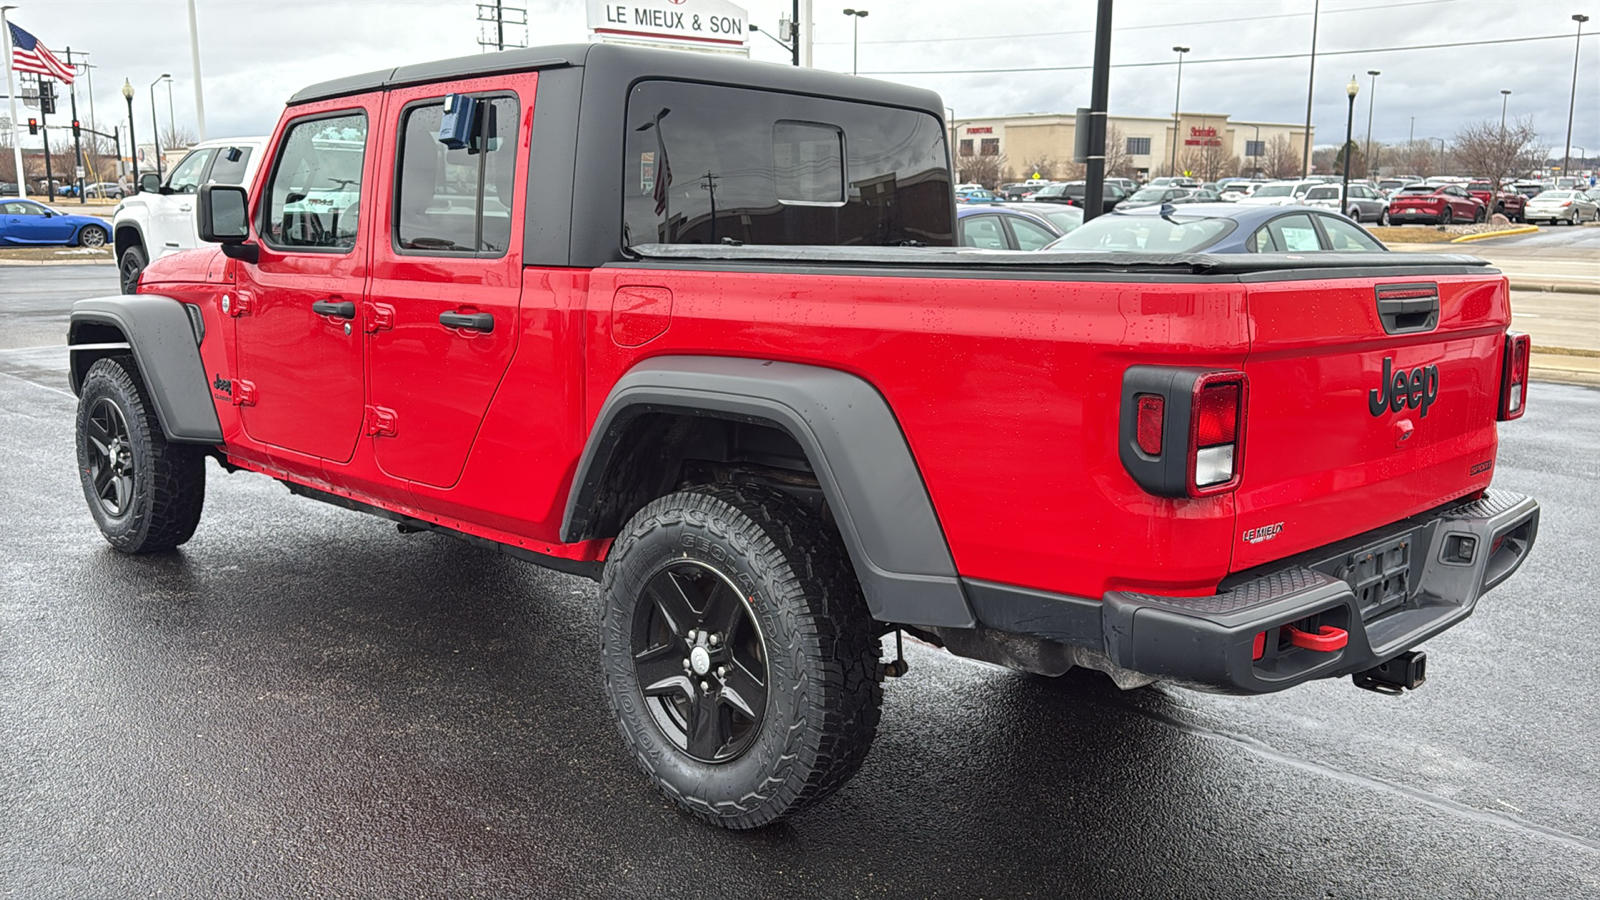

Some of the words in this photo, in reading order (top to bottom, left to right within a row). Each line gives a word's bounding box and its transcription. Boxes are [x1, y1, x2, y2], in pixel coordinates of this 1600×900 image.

[606, 5, 627, 24] LE
[634, 8, 685, 29] MIEUX
[692, 14, 703, 31] &
[710, 15, 742, 35] SON
[1368, 356, 1439, 418] Jeep
[1470, 461, 1492, 475] SPORT
[1242, 528, 1255, 542] LE
[1255, 521, 1285, 538] MIEUX
[609, 607, 665, 766] YOKOHAMA
